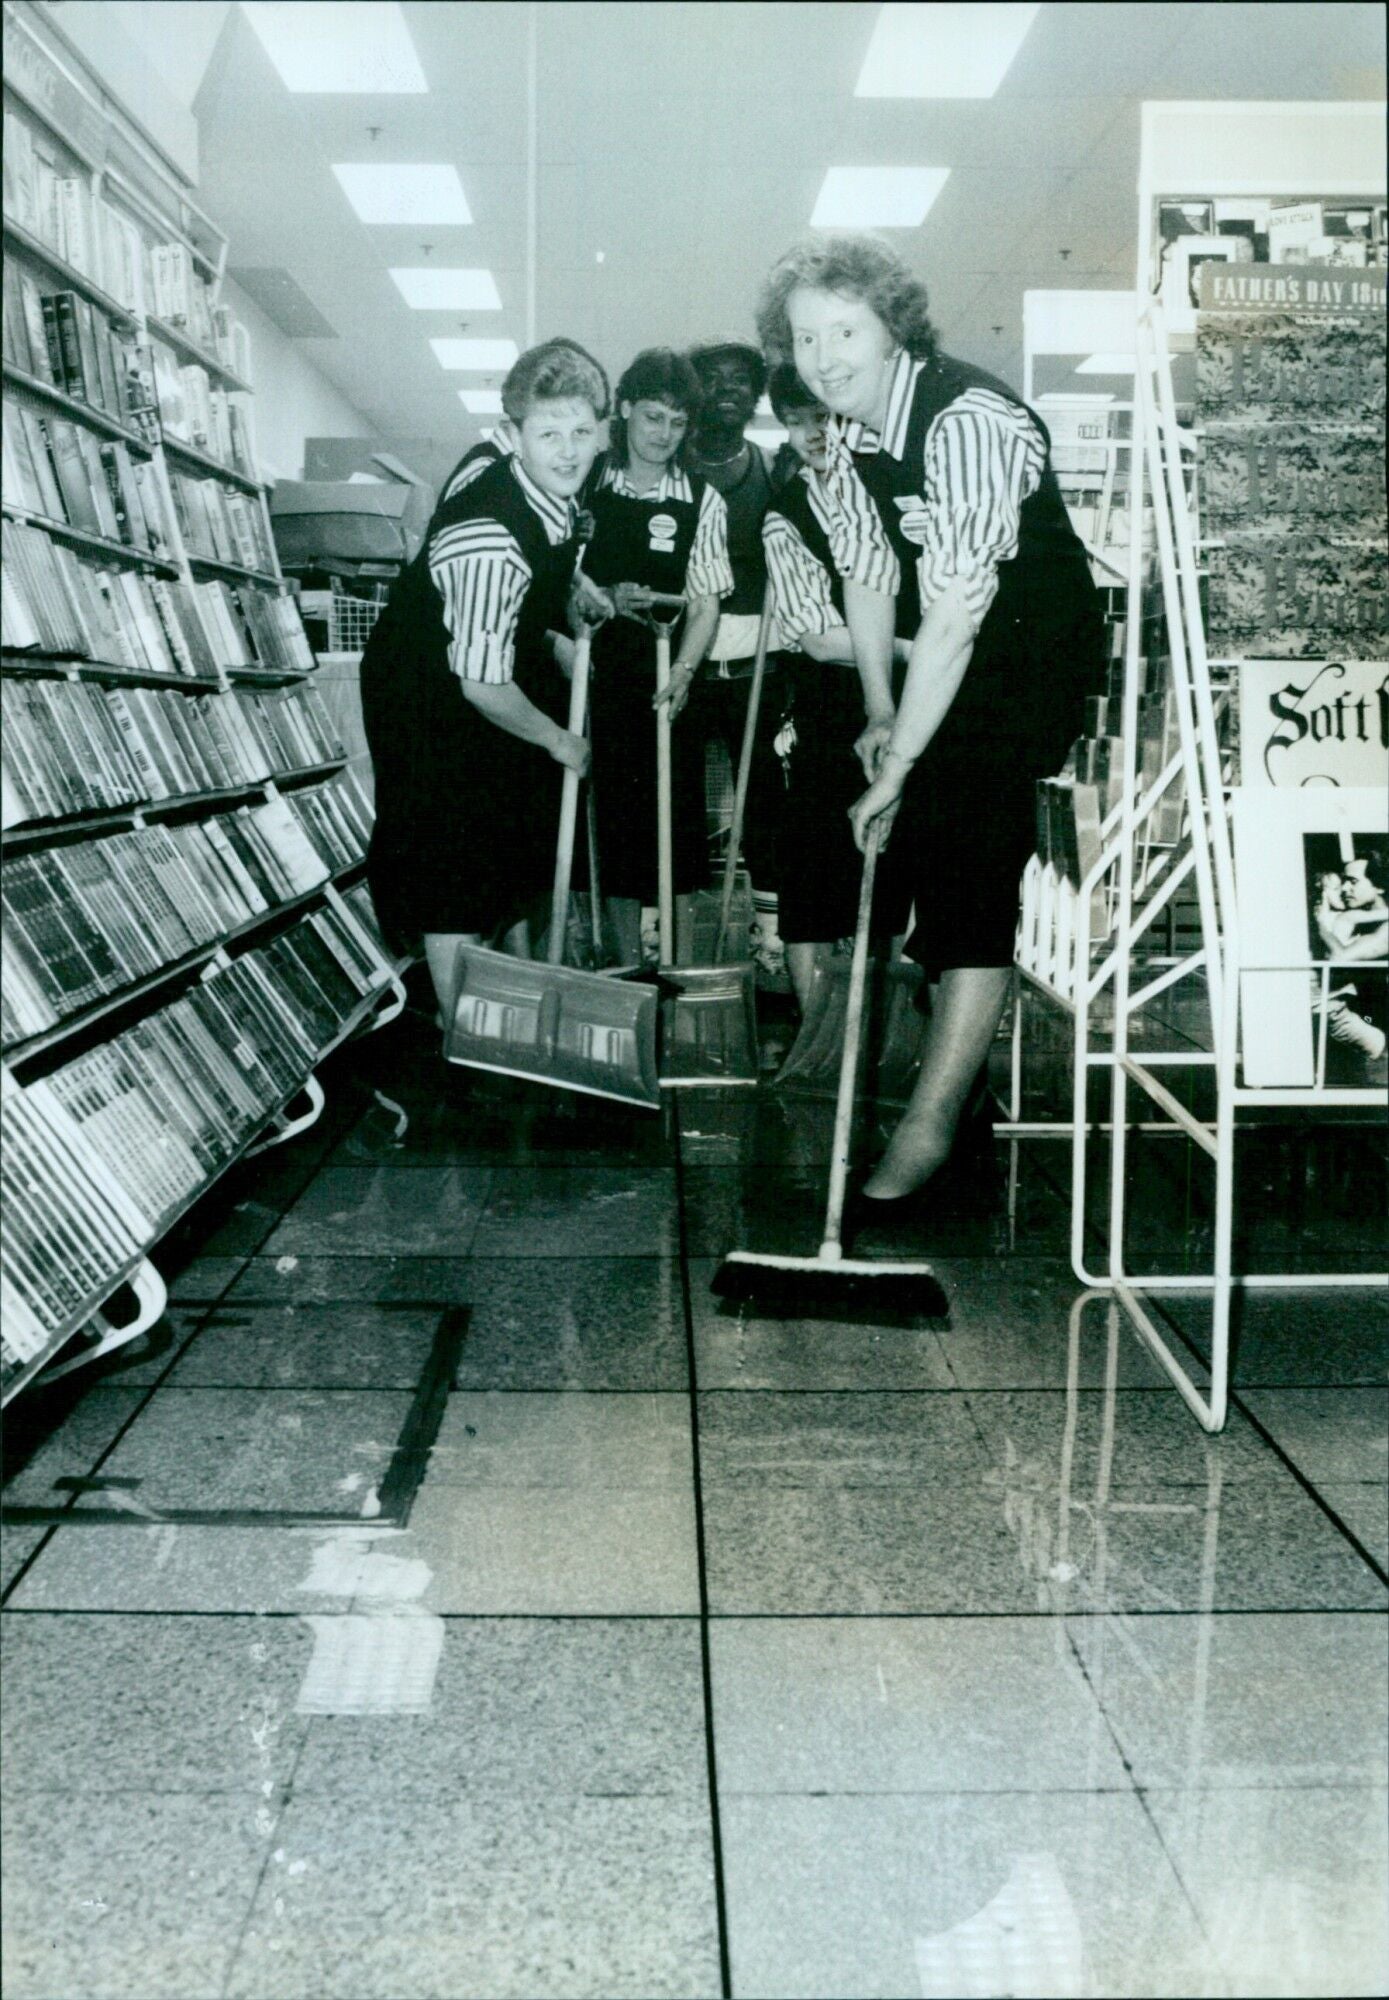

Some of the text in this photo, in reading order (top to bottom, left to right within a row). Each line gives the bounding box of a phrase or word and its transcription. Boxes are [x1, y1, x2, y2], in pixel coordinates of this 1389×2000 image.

[1213, 275, 1299, 302] FATHER'S
[1306, 280, 1343, 304] DAY
[1264, 664, 1372, 758] Soft
